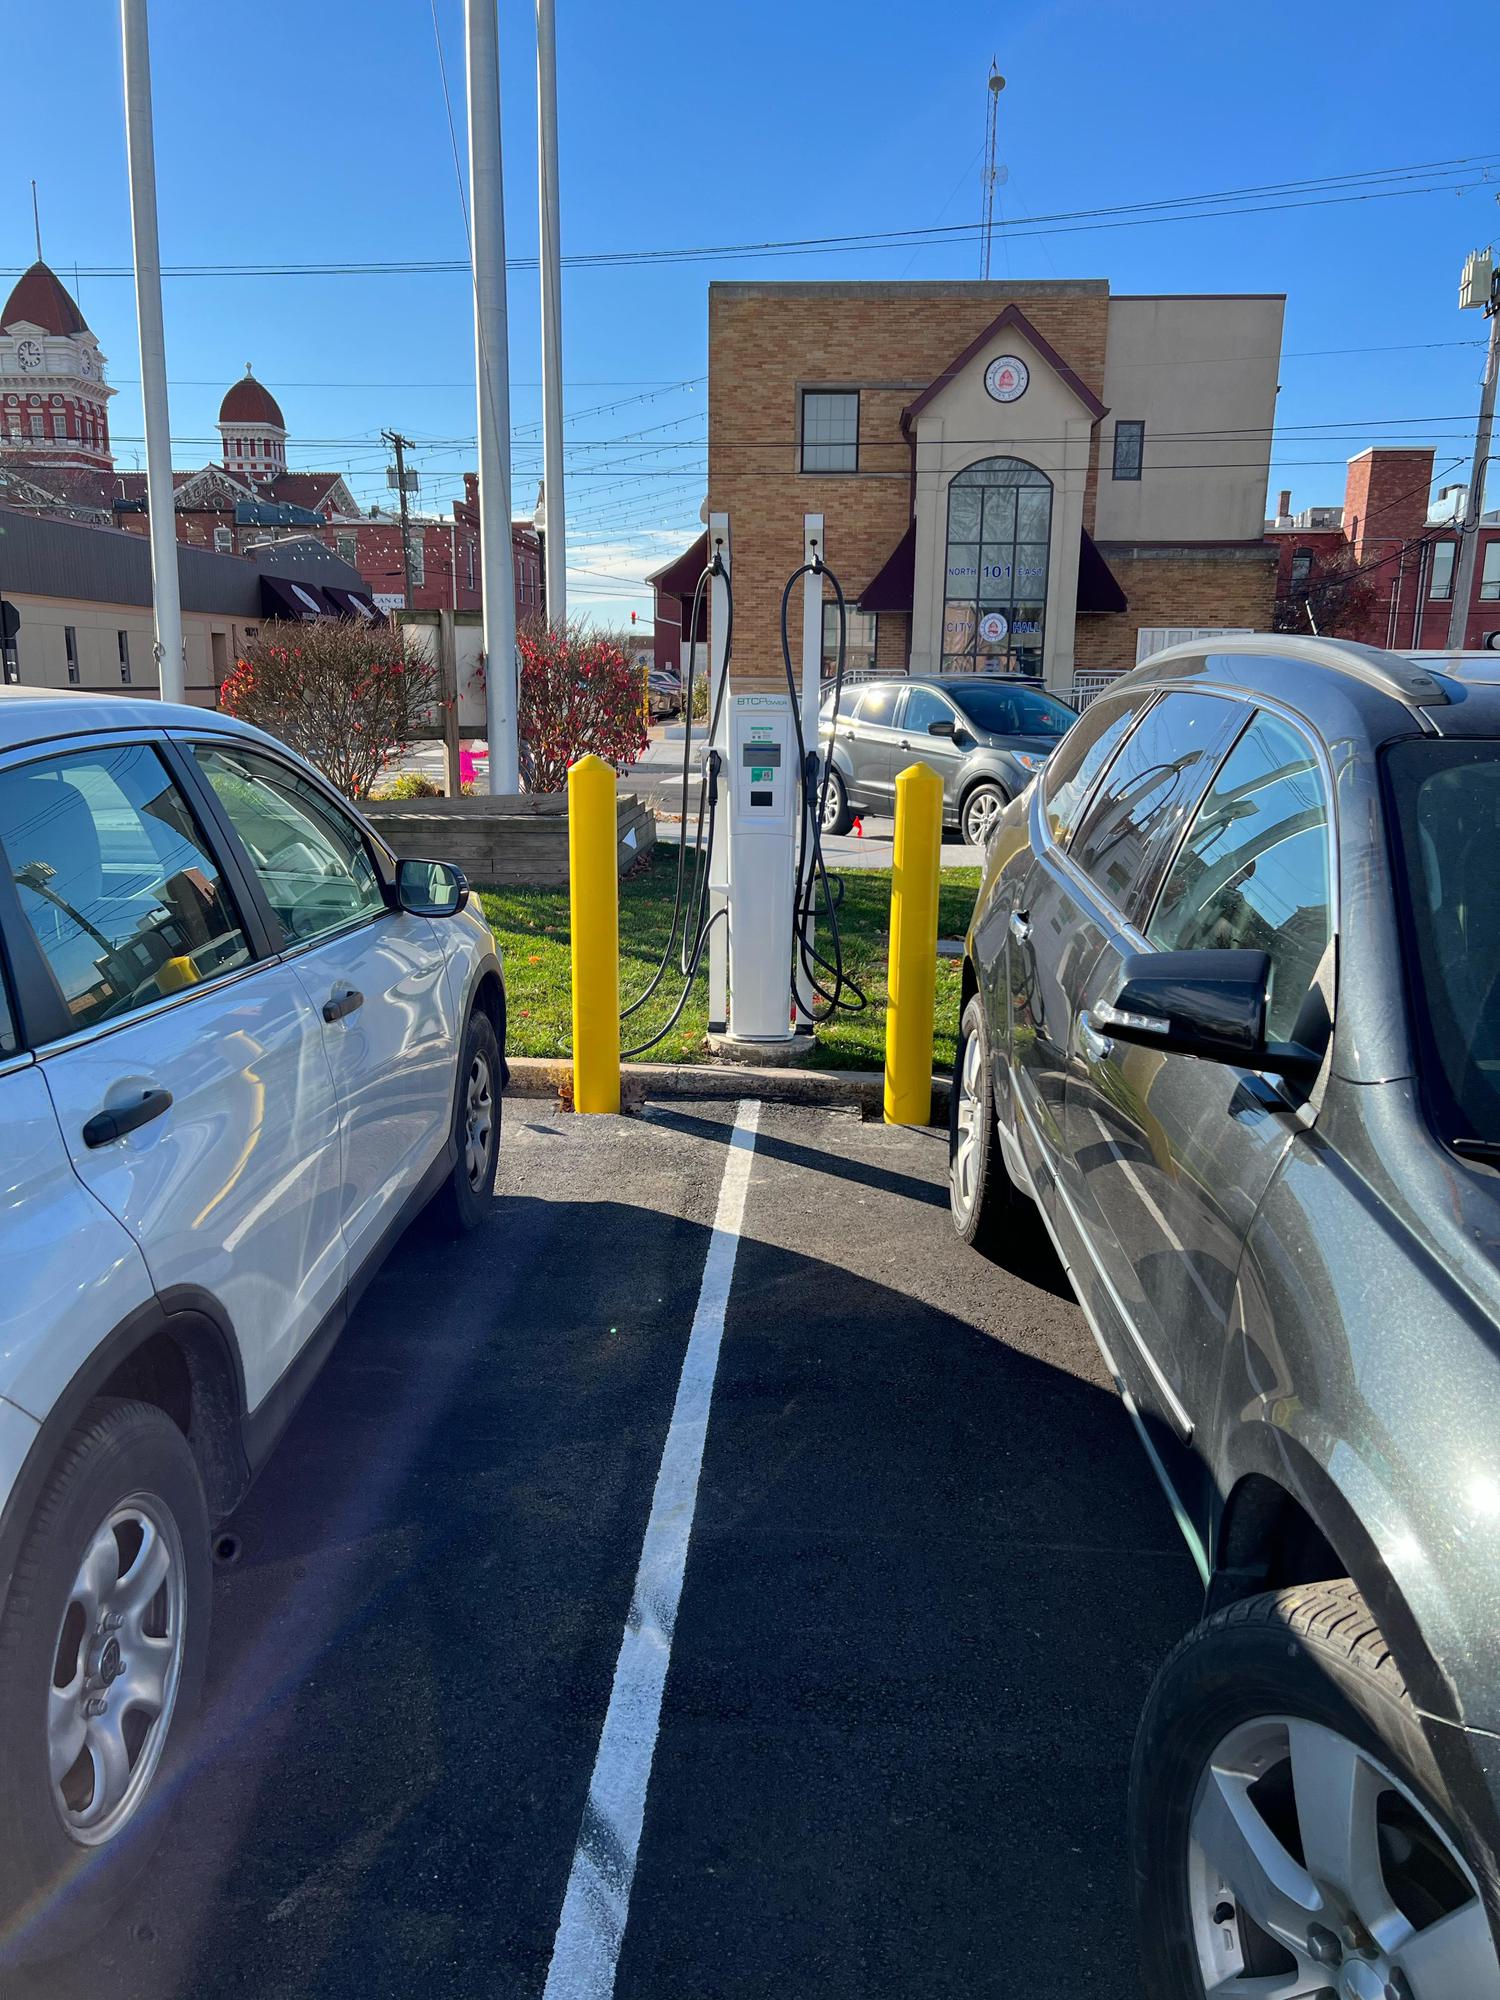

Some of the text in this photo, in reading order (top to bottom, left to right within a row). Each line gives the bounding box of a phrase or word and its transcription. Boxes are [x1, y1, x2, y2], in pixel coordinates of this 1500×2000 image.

[949, 566, 1043, 577] NORTH 101 EAST
[947, 621, 1041, 633] CITY HALL
